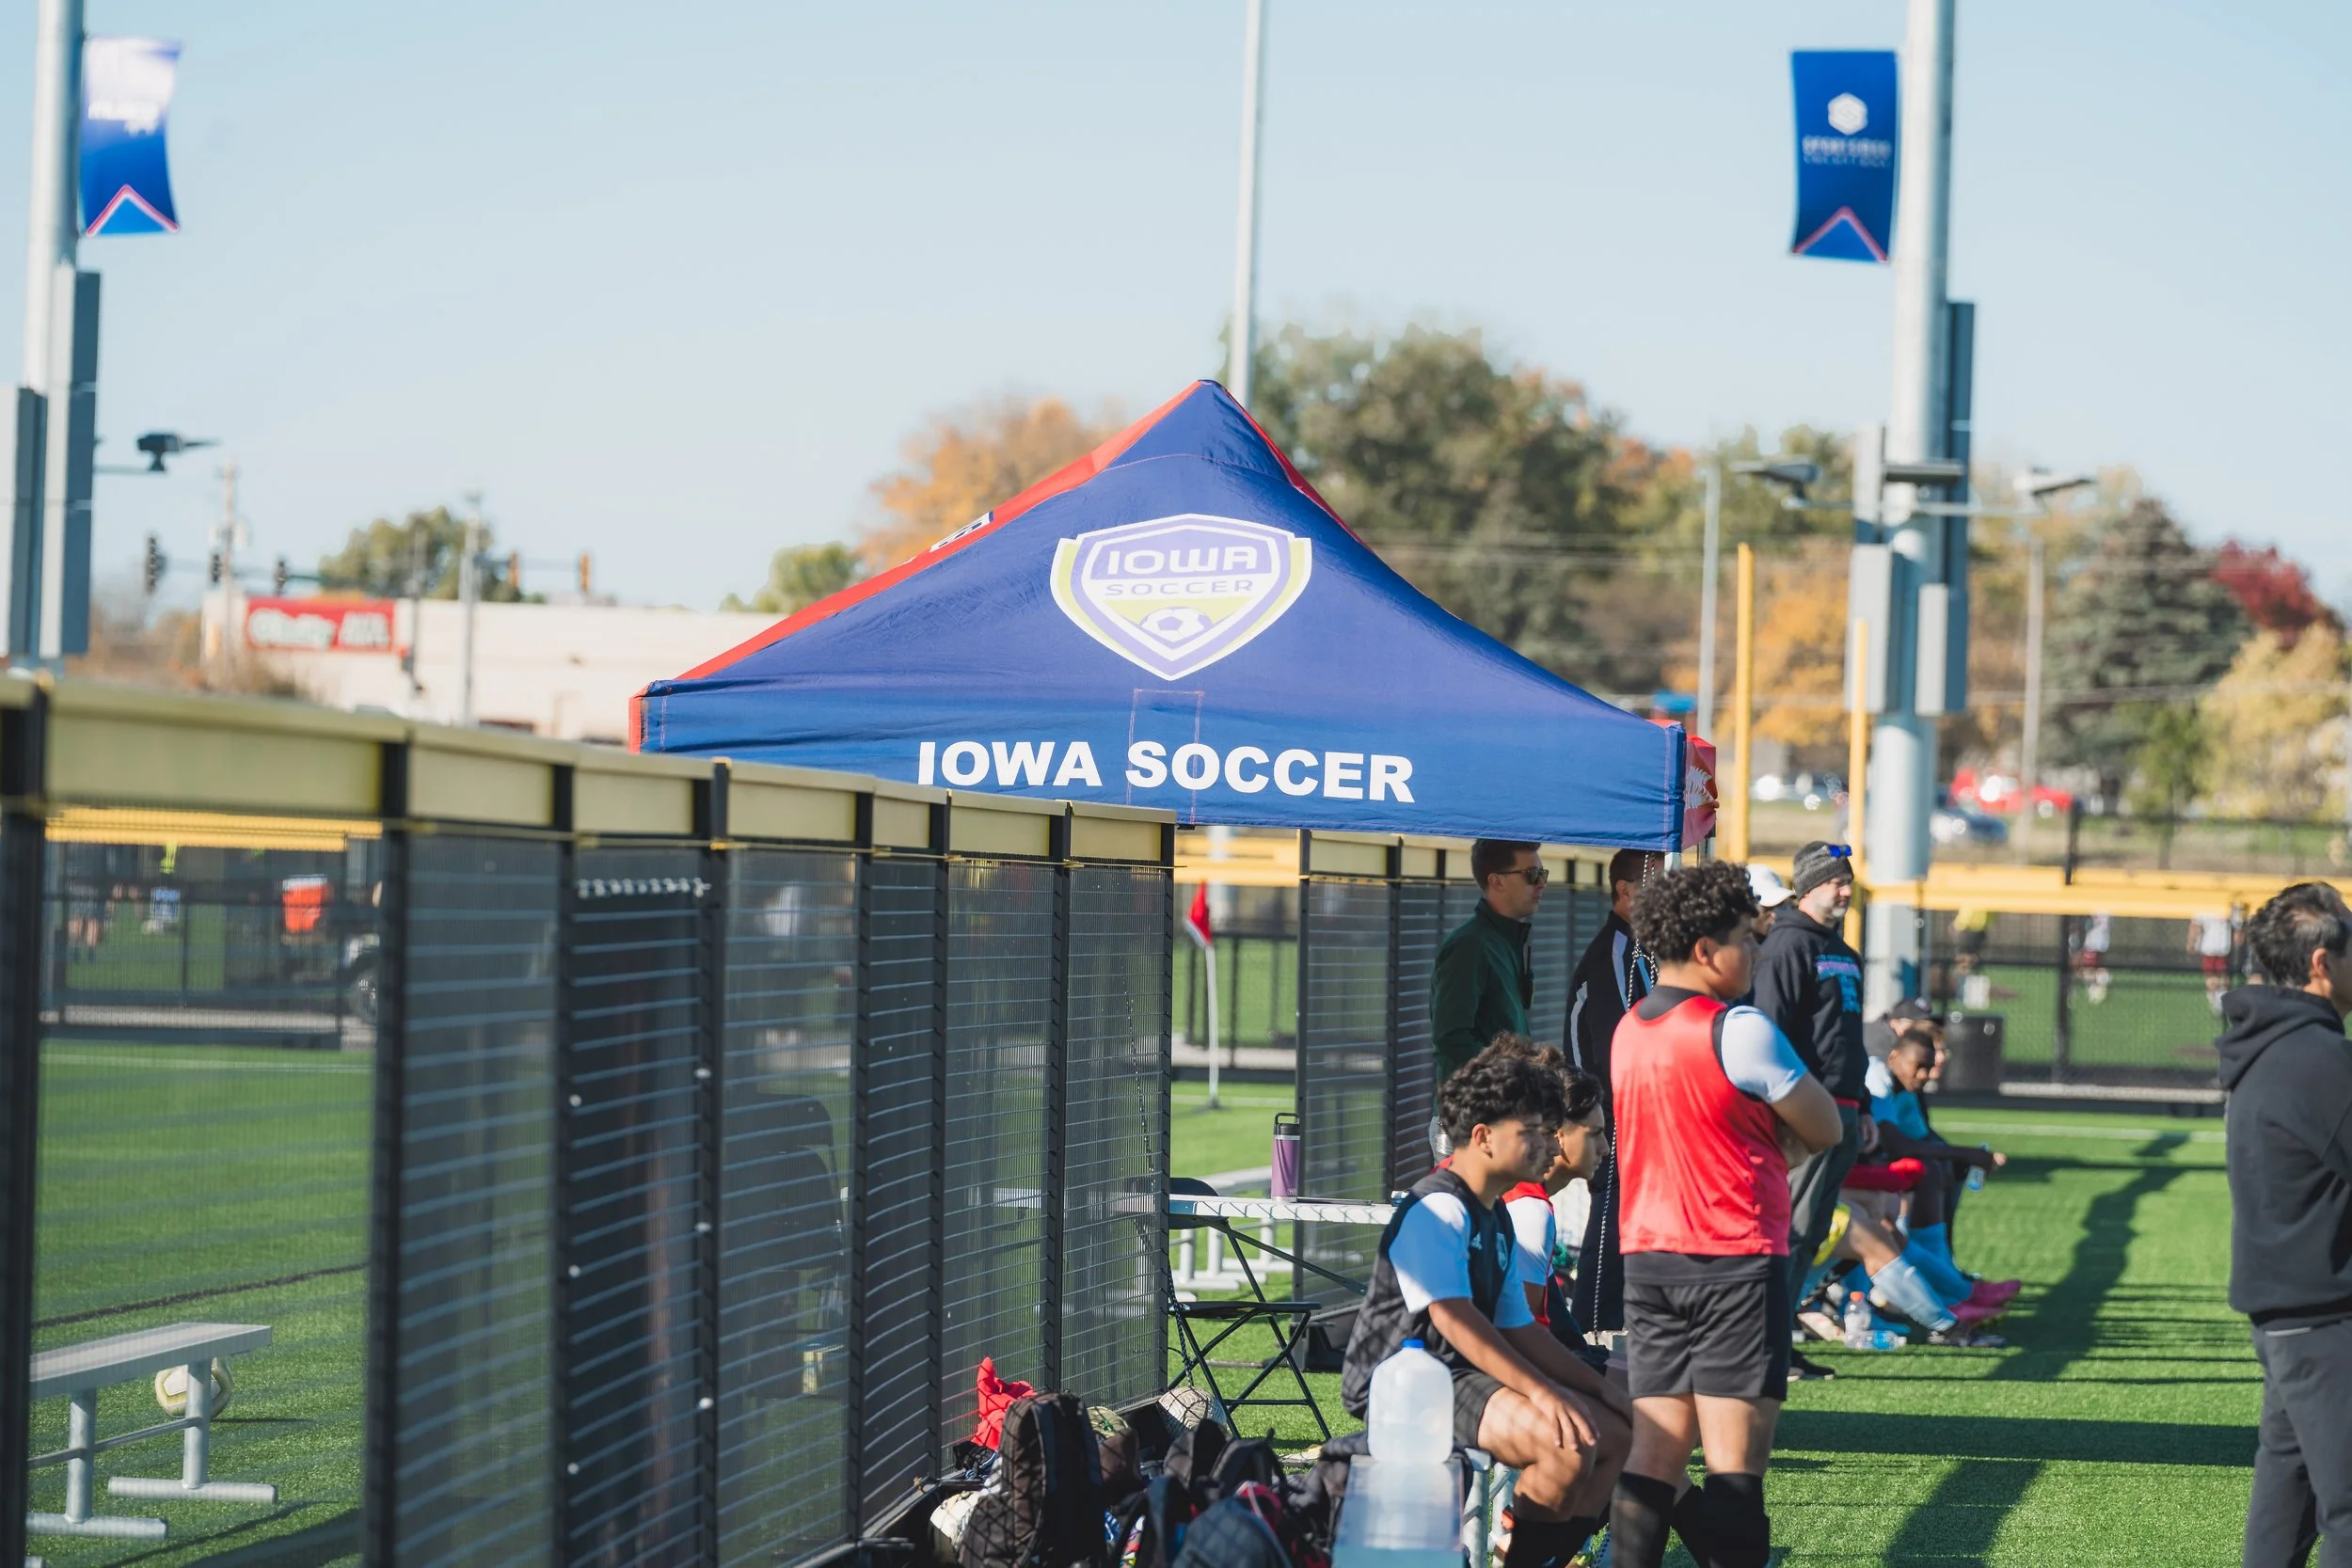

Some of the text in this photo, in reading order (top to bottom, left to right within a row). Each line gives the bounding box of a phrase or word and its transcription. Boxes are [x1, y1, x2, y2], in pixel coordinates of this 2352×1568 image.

[1107, 546, 1258, 575] IOWA
[1105, 579, 1253, 596] SOCCER
[918, 740, 1415, 803] IOWA SOCCER
